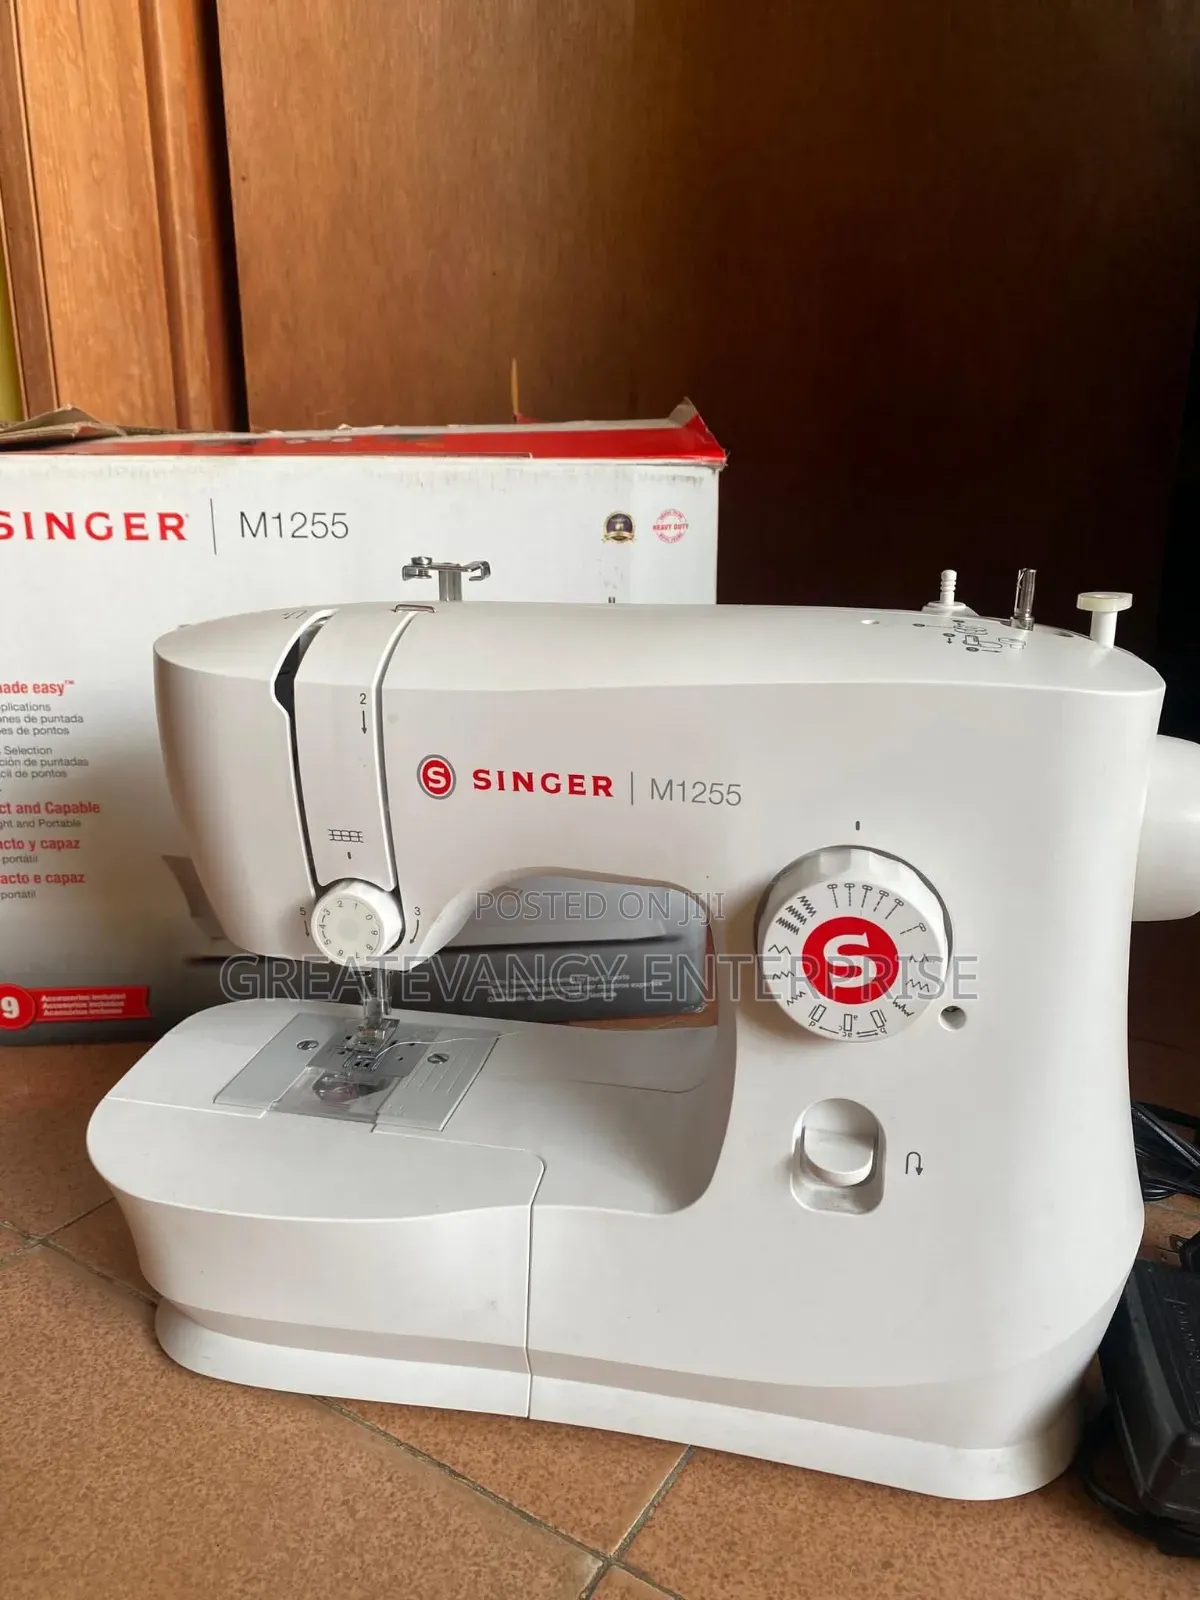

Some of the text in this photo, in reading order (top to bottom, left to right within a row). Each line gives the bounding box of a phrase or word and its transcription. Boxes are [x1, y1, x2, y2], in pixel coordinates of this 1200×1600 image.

[240, 511, 349, 539] M1255
[0, 681, 28, 694] ade
[359, 693, 367, 705] 2
[24, 714, 37, 723] de
[40, 714, 84, 725] puntada
[16, 726, 30, 735] de
[32, 726, 70, 737] pontos
[4, 746, 52, 755] Selection
[24, 757, 37, 767] de
[40, 757, 89, 768] puntadas
[15, 769, 28, 778] de
[31, 769, 67, 780] pontos
[472, 768, 742, 806] SINGER M1255
[16, 802, 41, 814] and
[45, 801, 101, 816] Capable
[16, 819, 35, 828] and
[39, 819, 81, 828] Portable
[28, 840, 36, 852] y
[40, 838, 80, 851] capaz
[33, 875, 41, 884] e
[45, 873, 85, 887] capaz
[337, 900, 344, 908] 2
[299, 906, 306, 916] 5
[323, 908, 331, 916] 3
[414, 906, 421, 916] 3
[823, 932, 877, 990] S
[1, 996, 20, 1019] 9
